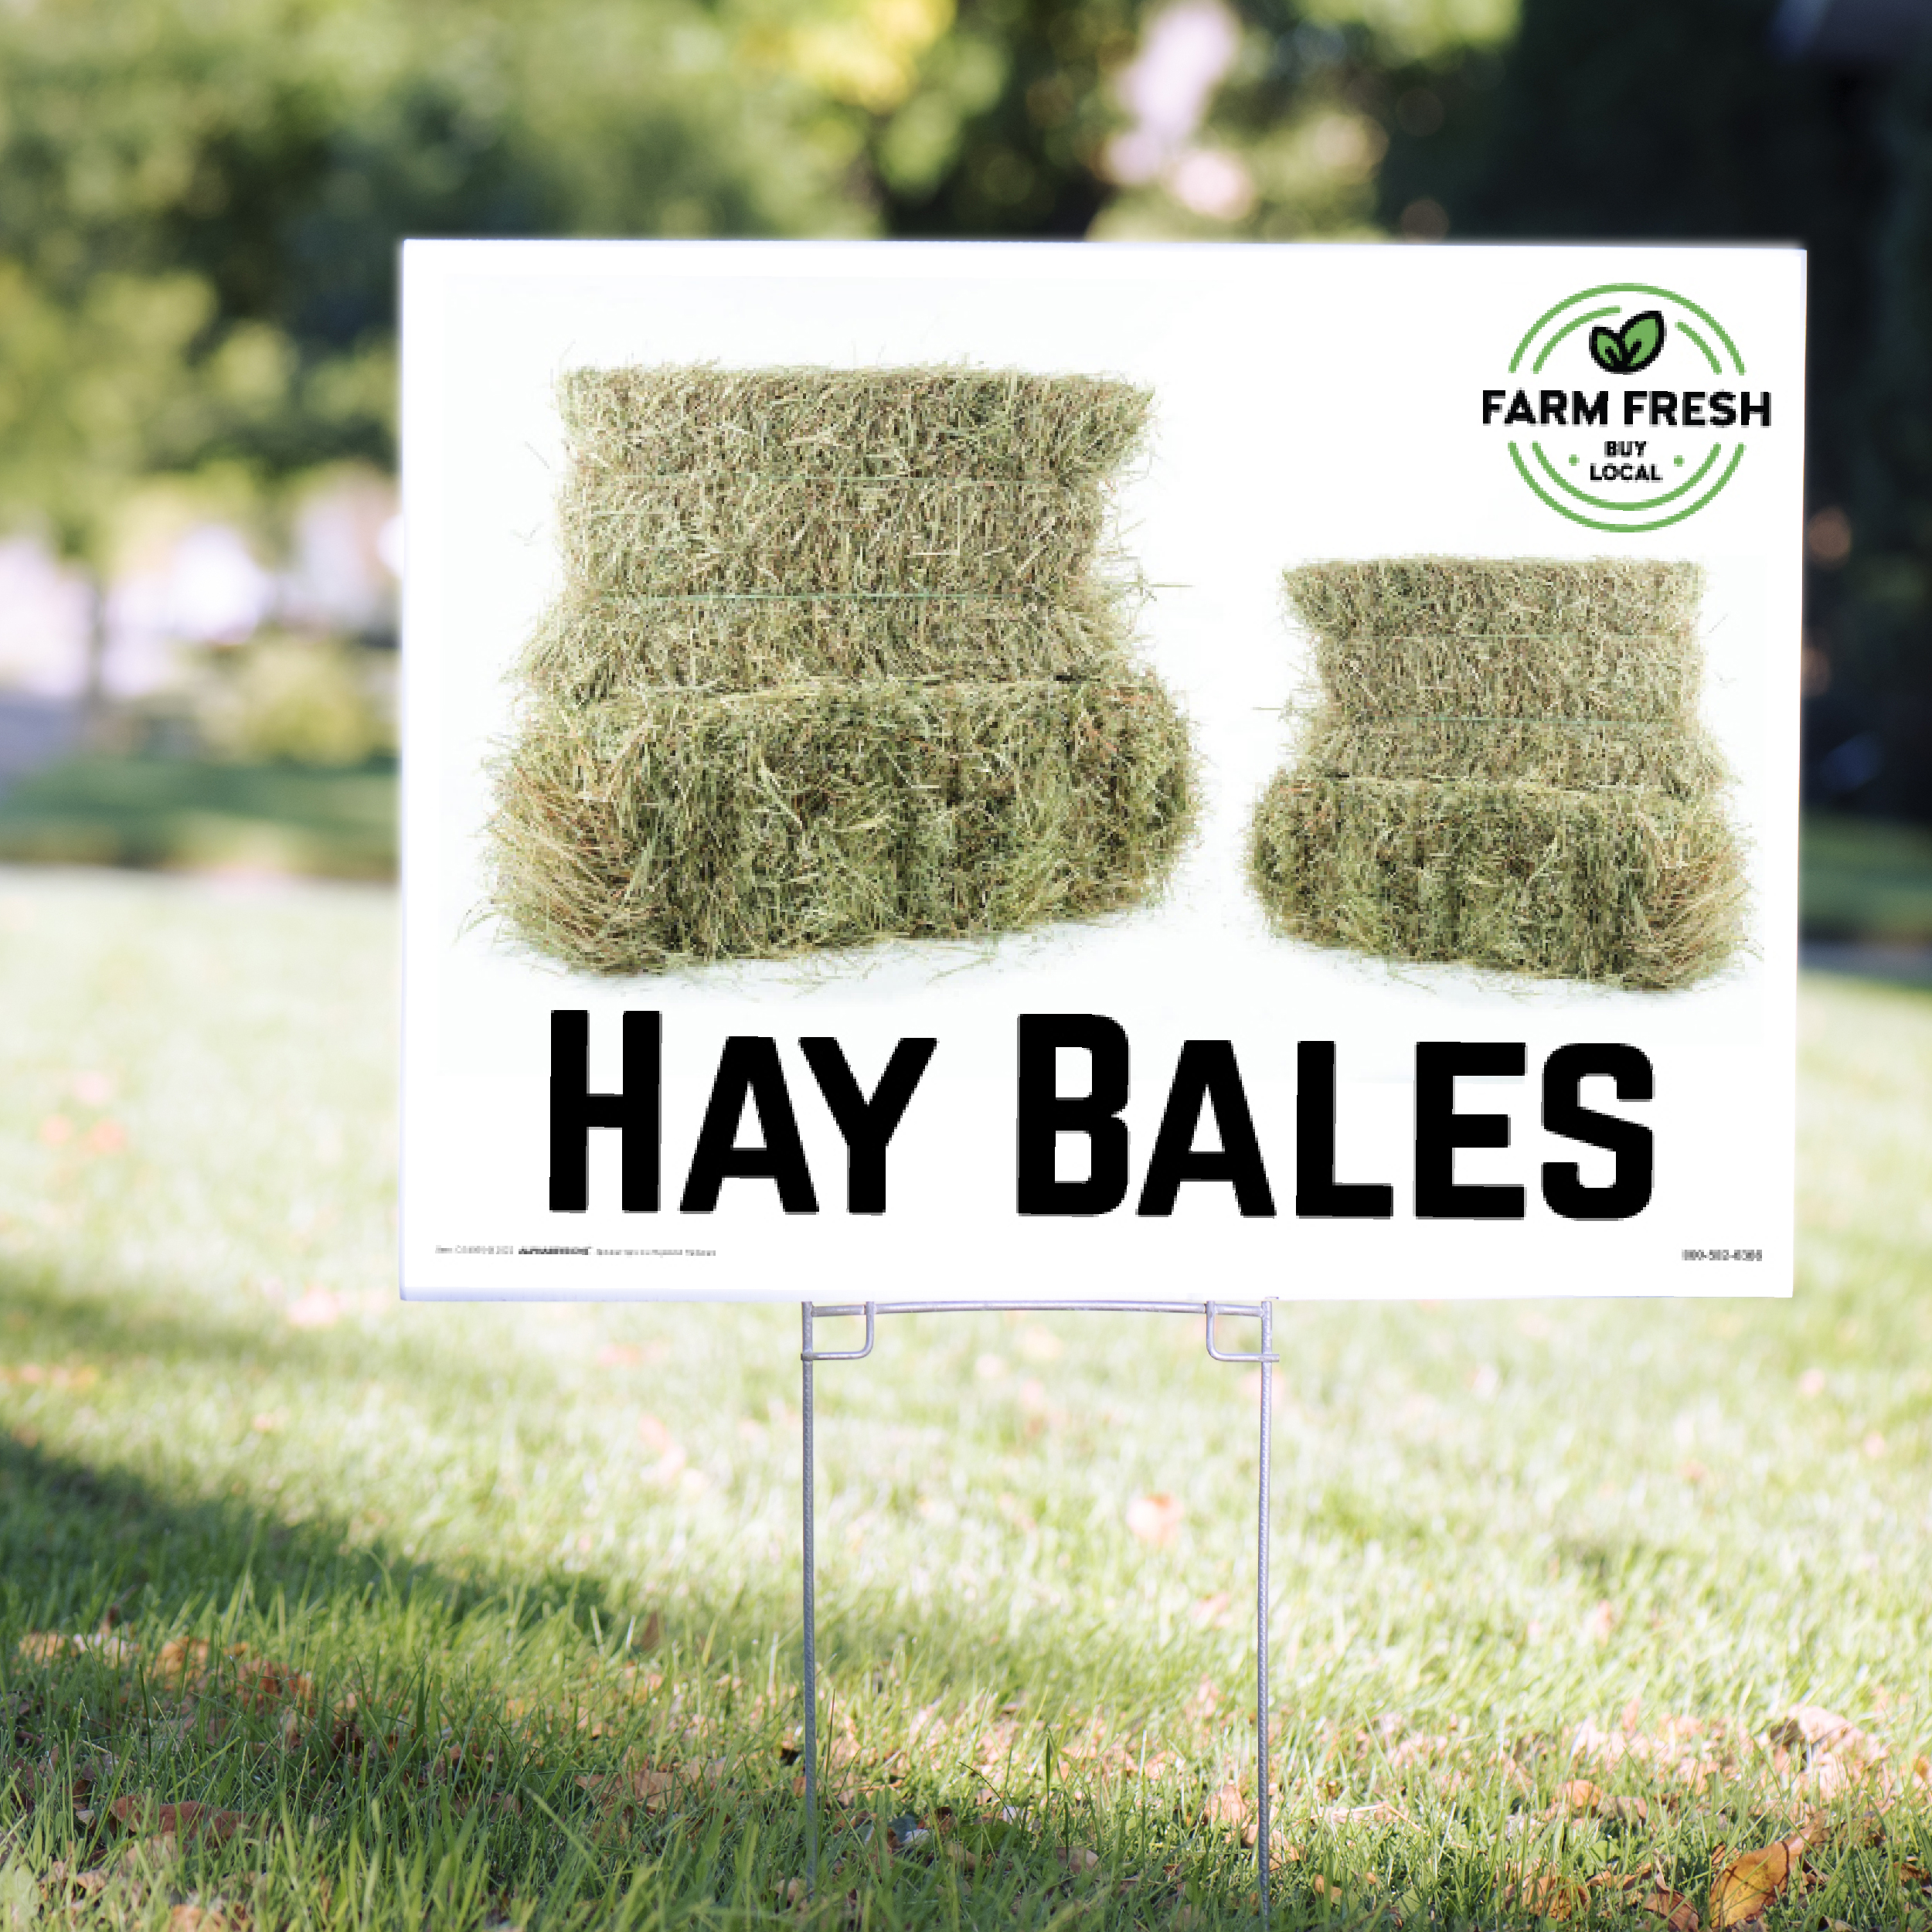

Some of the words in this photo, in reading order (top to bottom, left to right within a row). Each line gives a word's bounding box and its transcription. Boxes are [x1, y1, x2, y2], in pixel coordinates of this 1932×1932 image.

[1482, 389, 1610, 426] FARM
[1623, 390, 1771, 427] FRESH
[1604, 440, 1648, 457] BUY
[1589, 464, 1662, 482] LOCAL
[549, 1009, 938, 1215] HAY
[1017, 1013, 1655, 1221] BALES
